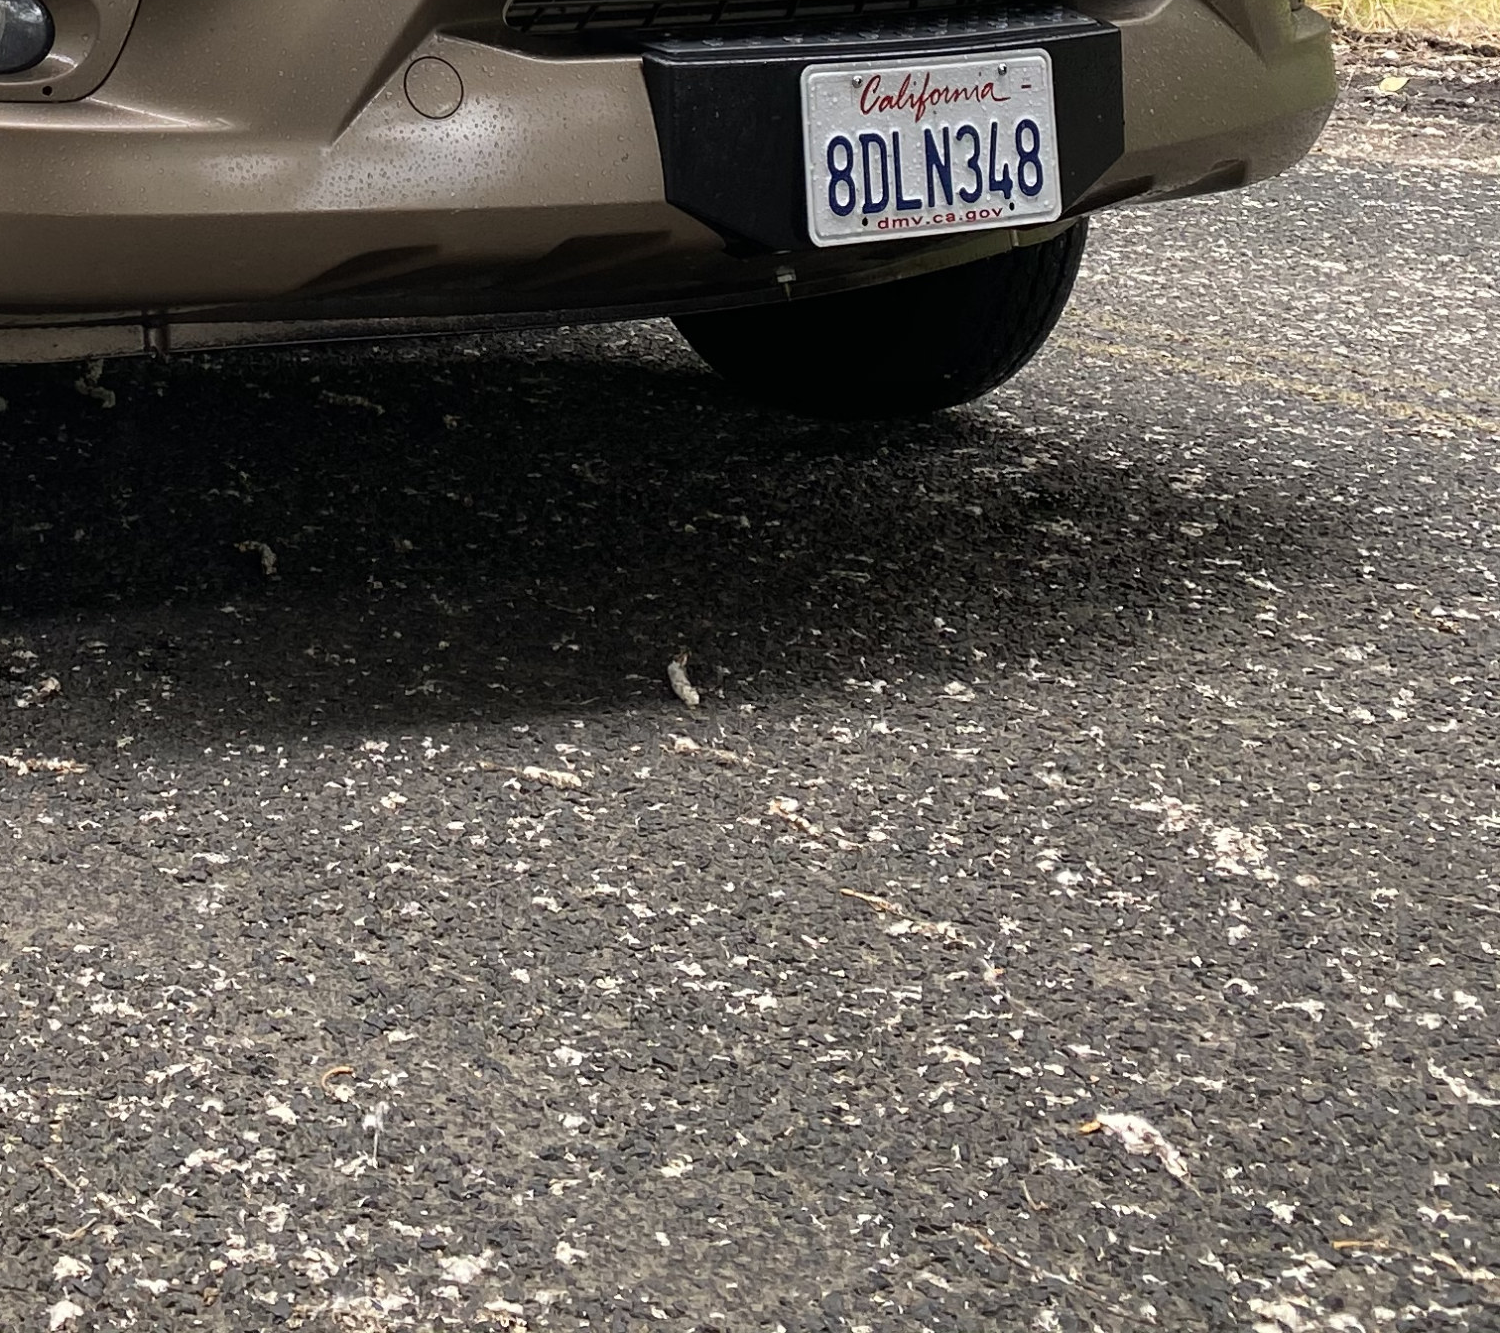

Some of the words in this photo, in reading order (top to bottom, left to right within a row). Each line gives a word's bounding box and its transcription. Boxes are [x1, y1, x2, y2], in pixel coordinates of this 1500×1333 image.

[859, 72, 1011, 123] California
[826, 118, 1044, 217] 8DLN348
[877, 206, 1003, 230] dmv.ca.gov
